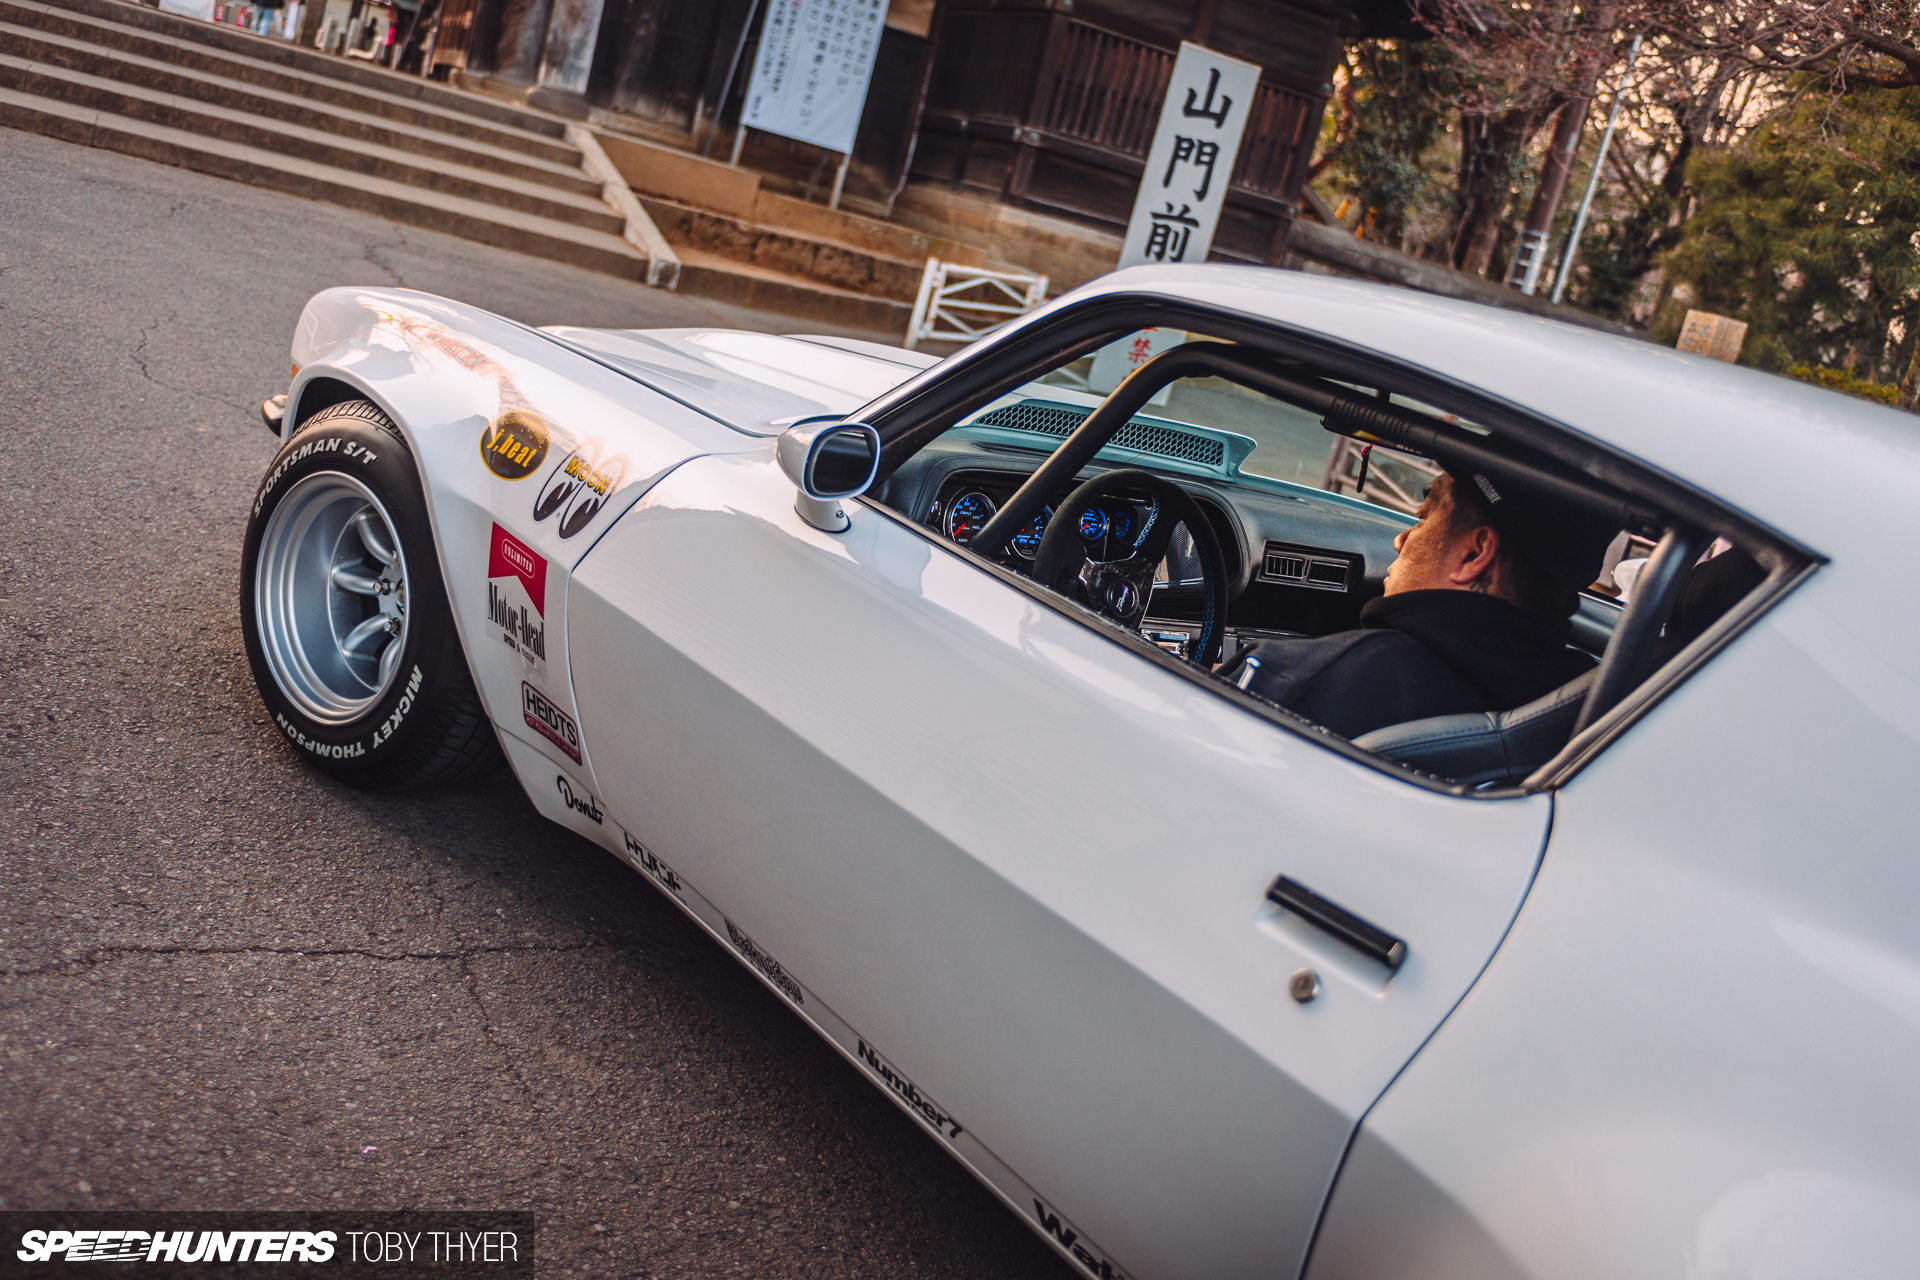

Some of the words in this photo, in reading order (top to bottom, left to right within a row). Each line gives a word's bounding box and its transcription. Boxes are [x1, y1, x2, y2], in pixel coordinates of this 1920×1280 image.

[1146, 68, 1232, 263] 山門前
[254, 438, 342, 518] SPORTSMAN
[343, 441, 378, 465] S/T
[564, 455, 613, 496] MOON
[504, 544, 533, 573] UNLIMITED
[488, 581, 546, 662] Motor-Head
[276, 713, 365, 758] THOMPSON
[373, 665, 423, 749] MICKEY
[526, 688, 577, 746] HEIDTS
[858, 1038, 963, 1139] Number7
[1033, 1197, 1125, 1280] Wat
